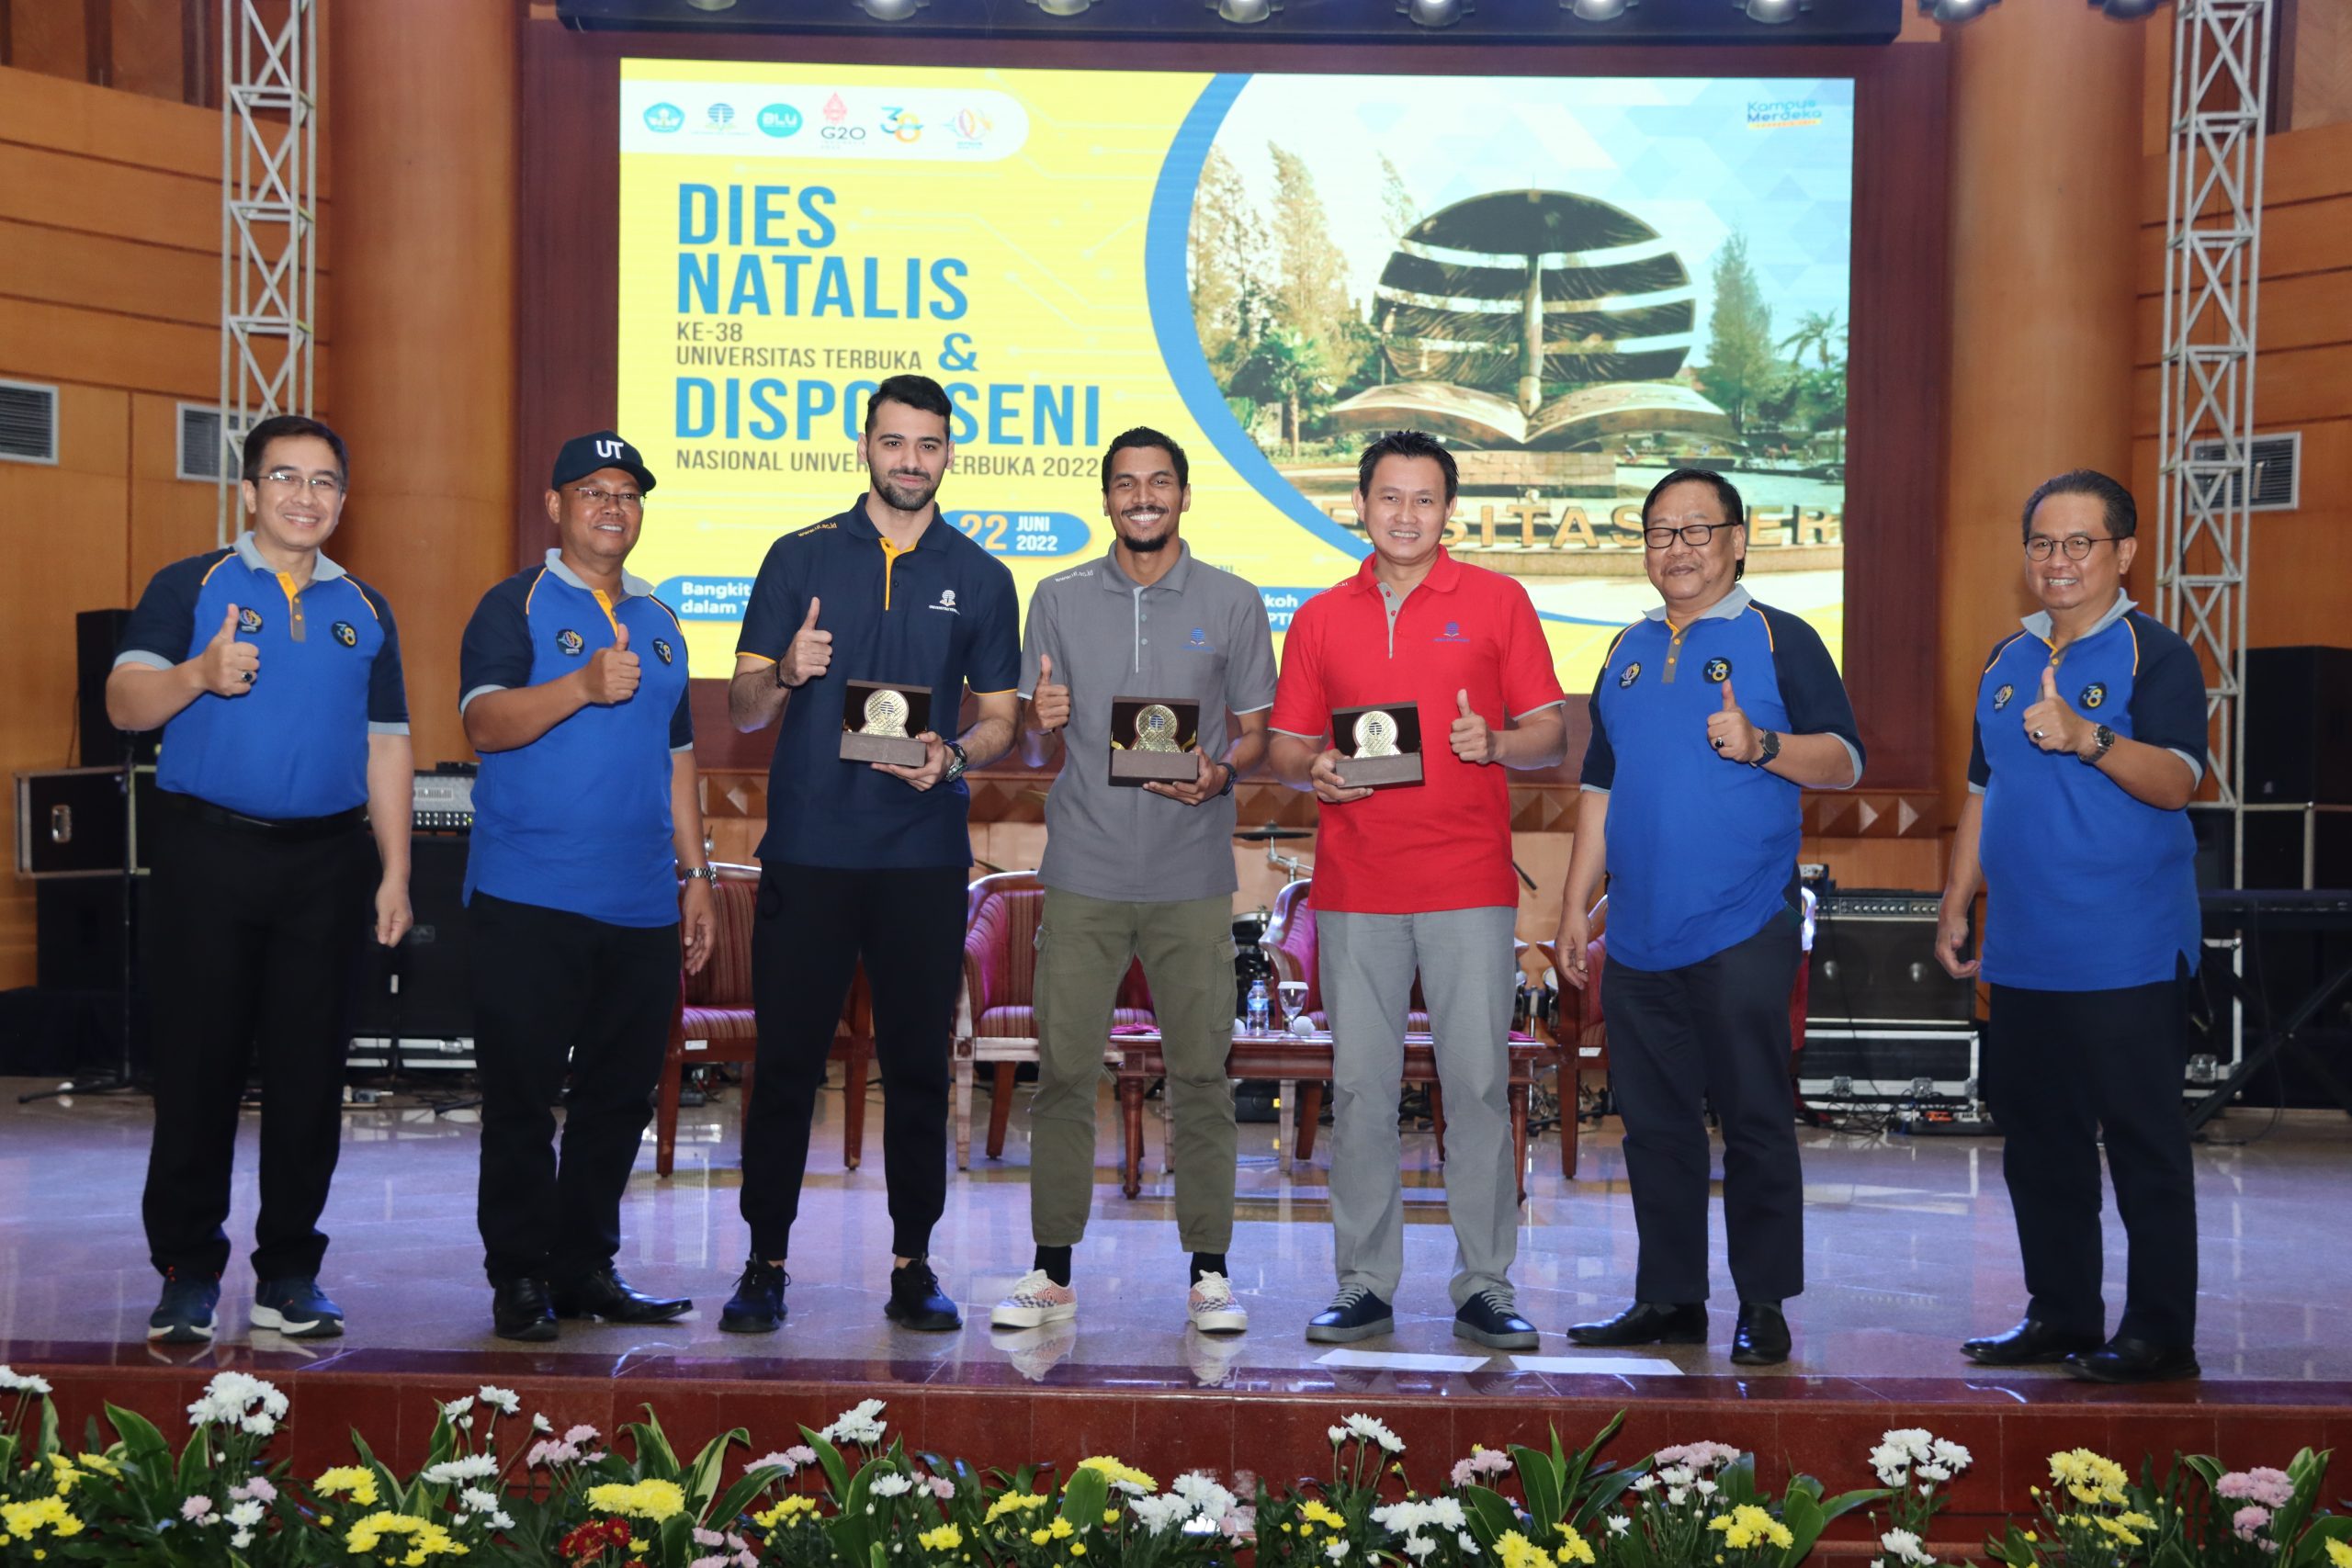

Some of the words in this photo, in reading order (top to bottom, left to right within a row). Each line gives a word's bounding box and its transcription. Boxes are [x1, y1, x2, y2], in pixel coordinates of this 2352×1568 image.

[1747, 99, 1816, 111] Kampus
[762, 112, 797, 127] BLU
[1747, 109, 1822, 122] Merdeka
[820, 126, 866, 140] G20
[678, 183, 837, 249] DIES
[677, 253, 969, 321] NATALIS
[676, 321, 743, 342] KE-38
[676, 345, 816, 367] UNIVERSITAS
[823, 348, 922, 370] TERBUKA
[937, 332, 979, 371] &
[675, 377, 1100, 446] DISPOSENI
[595, 440, 625, 459] UT
[676, 450, 784, 471] NASIONAL
[950, 456, 1035, 476] ERBUKA
[1043, 457, 1099, 477] 2022
[1016, 515, 1050, 532] JUNI
[1016, 535, 1057, 551] 2022
[681, 581, 752, 599] Bangkit
[681, 599, 737, 614] dalam
